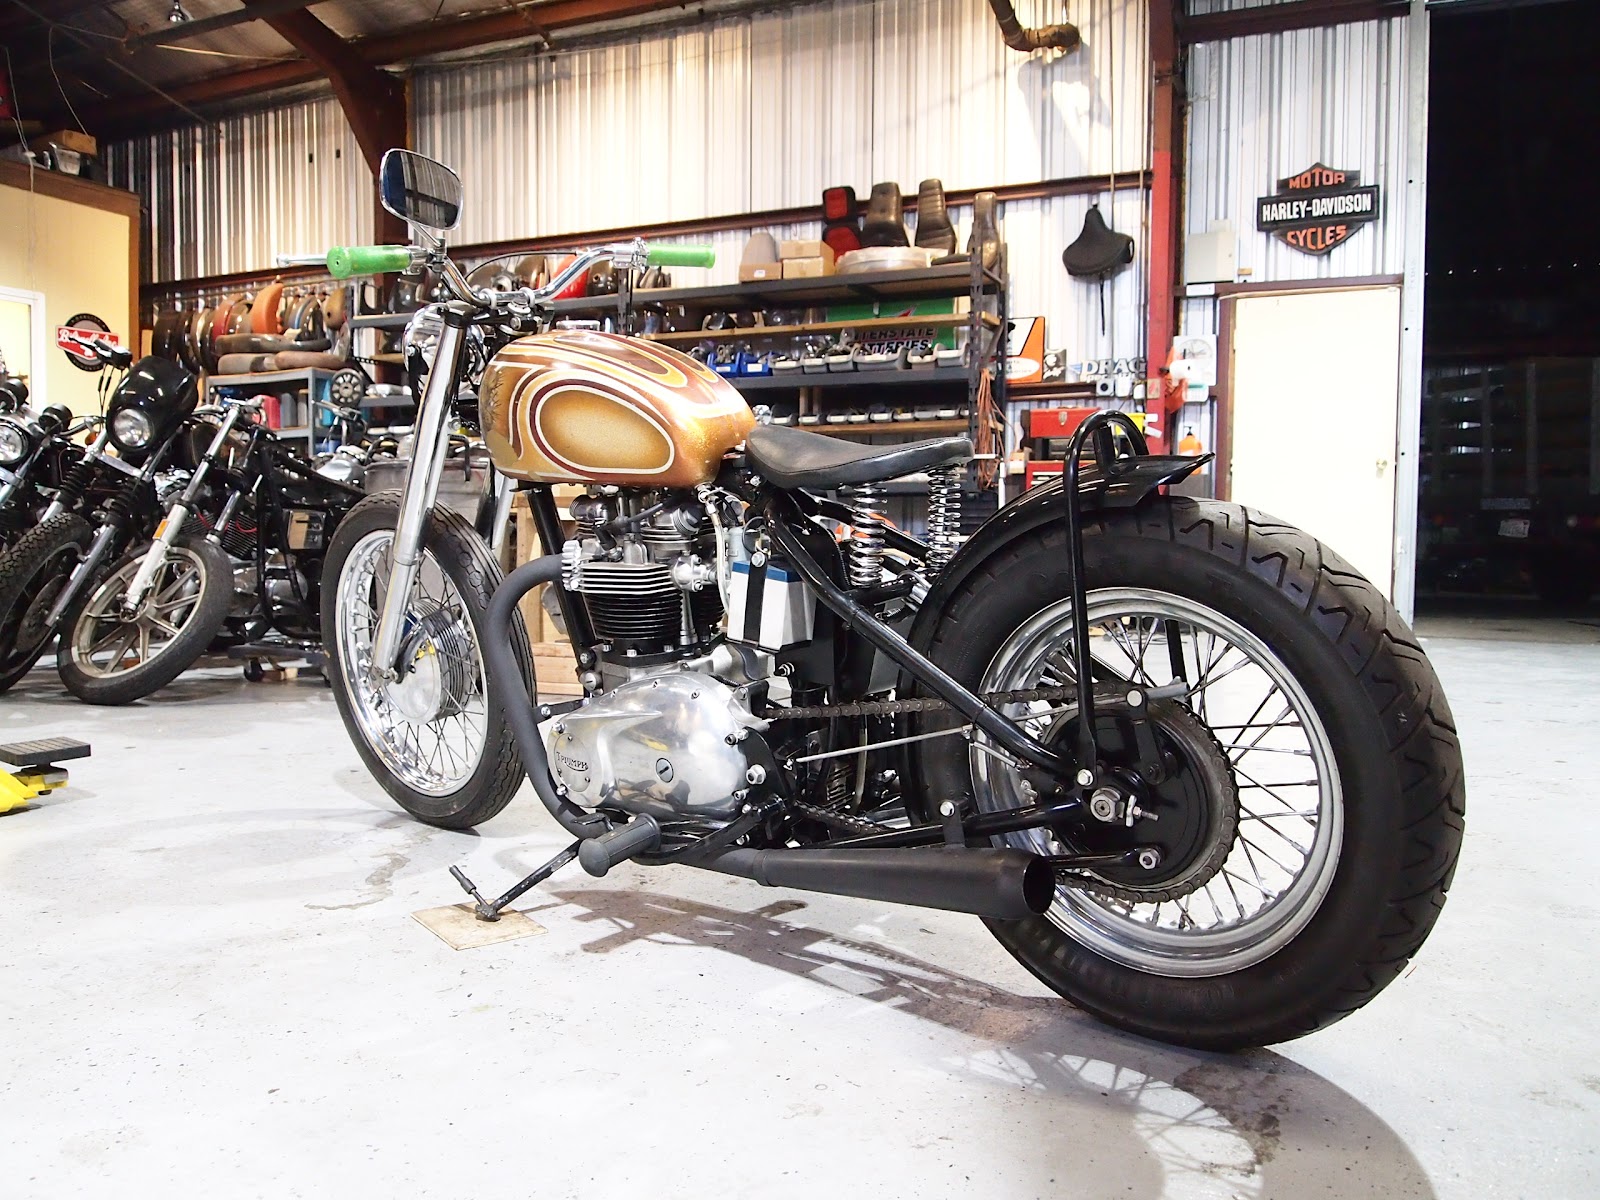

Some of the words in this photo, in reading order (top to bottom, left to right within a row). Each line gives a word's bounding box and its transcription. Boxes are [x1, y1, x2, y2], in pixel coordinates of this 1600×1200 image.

[1289, 167, 1345, 189] MOTOR
[1262, 193, 1372, 222] HARLEY-DAVIDSON
[1286, 224, 1347, 251] CYCLES
[556, 751, 589, 771] TRIUMPH
